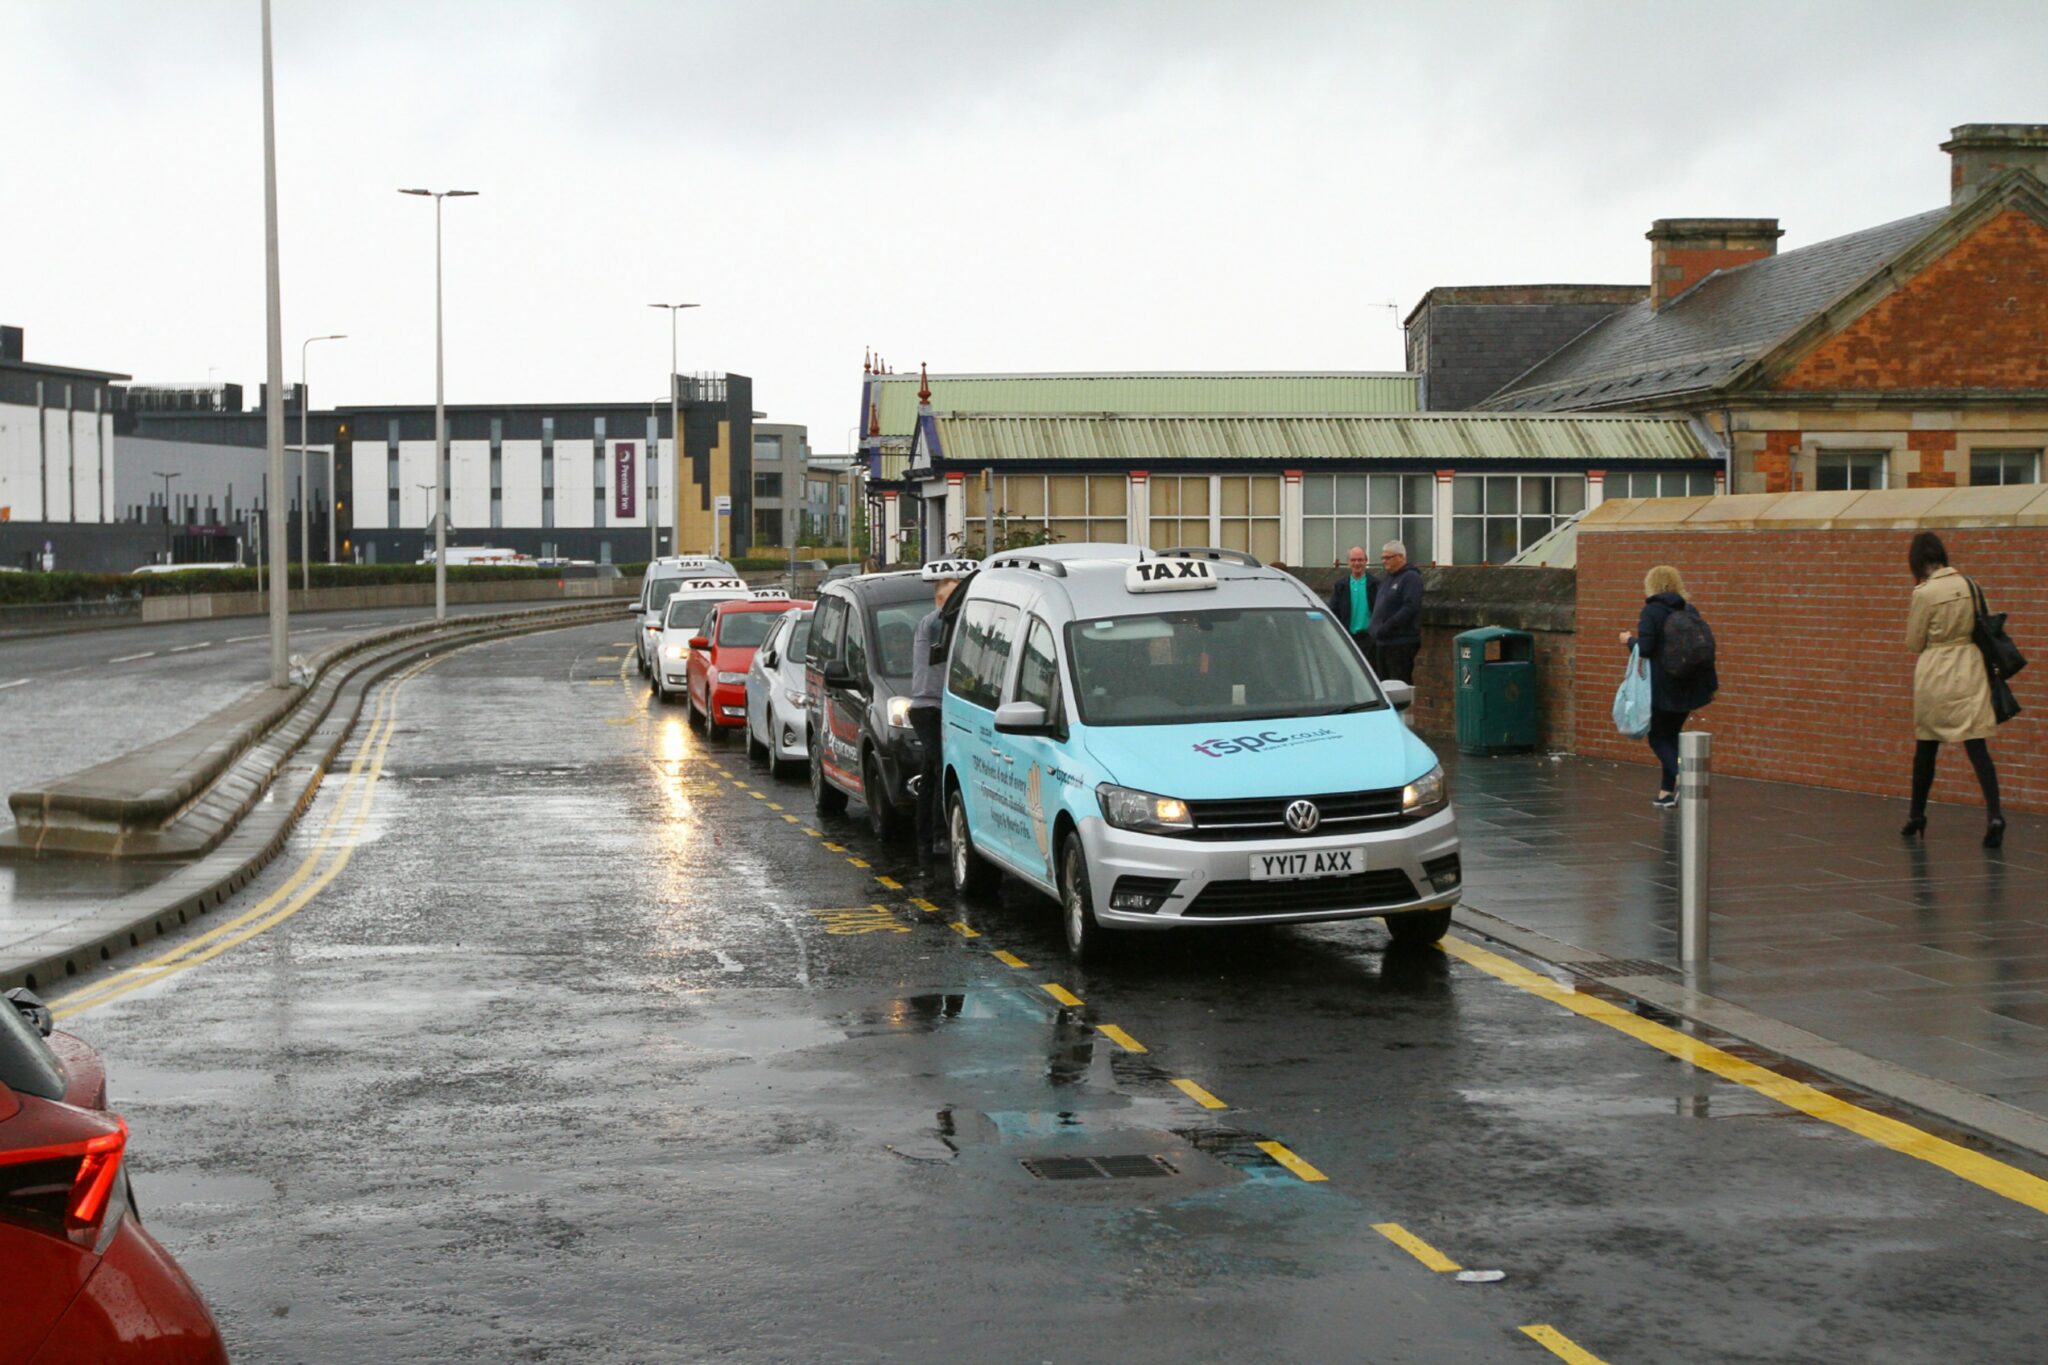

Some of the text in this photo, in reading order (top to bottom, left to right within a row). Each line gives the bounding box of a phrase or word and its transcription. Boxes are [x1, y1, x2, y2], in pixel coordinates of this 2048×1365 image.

[621, 464, 630, 511] Premier Inn
[928, 561, 978, 573] TAXI
[1136, 561, 1209, 581] TAXI
[689, 581, 740, 589] TAXI
[1262, 851, 1352, 876] YY17 AXX
